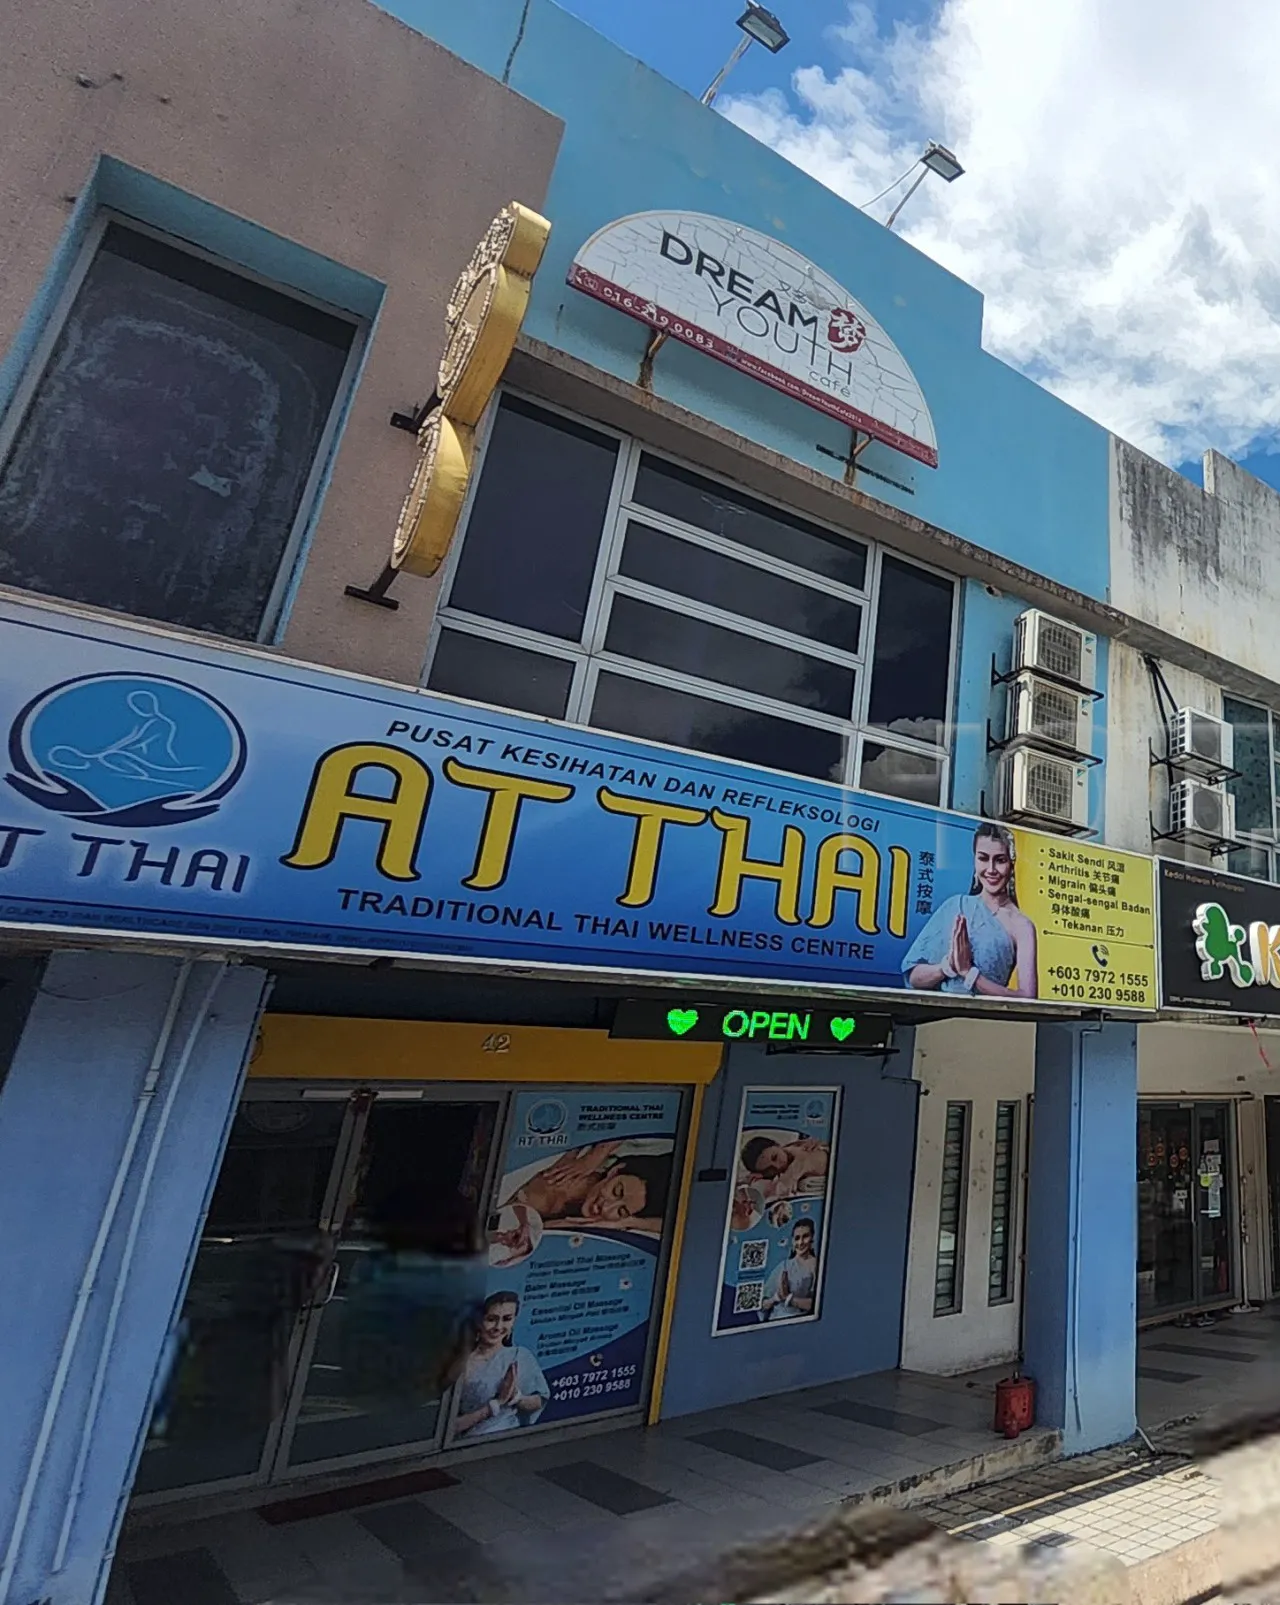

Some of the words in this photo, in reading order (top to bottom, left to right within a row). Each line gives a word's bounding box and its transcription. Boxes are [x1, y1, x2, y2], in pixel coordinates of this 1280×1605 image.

[660, 230, 818, 328] DREAM
[674, 322, 714, 350] 0083
[707, 283, 852, 385] YOUTH
[386, 720, 495, 755] PUSAT
[500, 744, 658, 788] KESIHATAN
[664, 777, 716, 799] DAN
[722, 789, 881, 833] REFLEKSOLOGI
[279, 741, 574, 892] AT
[596, 785, 911, 939] THAI
[0, 824, 46, 869] T
[71, 832, 251, 893] THAI
[1048, 848, 1075, 860] Sakit
[1077, 854, 1105, 868] Sendi
[1048, 862, 1090, 878] Arthritis
[915, 851, 935, 915] 泰式按摩
[1048, 875, 1086, 890] Migrain
[1048, 888, 1119, 910] Sengal-sengal
[1121, 902, 1151, 915] Badan
[338, 888, 563, 931] TRADITIONAL
[574, 914, 638, 939] THAI
[649, 922, 783, 950] WELLNESS
[791, 937, 875, 960] CENTRE
[1061, 918, 1104, 934] Tekanan
[1106, 925, 1125, 937] 压力
[1047, 966, 1080, 981] +603
[1084, 969, 1116, 984] 7972
[1119, 973, 1149, 987] 1555
[1051, 984, 1085, 998] +010
[1088, 986, 1112, 1000] 230
[1115, 988, 1145, 1003] 9588
[722, 1010, 811, 1040] OPEN
[482, 1033, 511, 1053] 42
[518, 1136, 533, 1145] AT
[540, 1135, 568, 1144] THAI
[549, 1280, 587, 1289] Massage
[587, 1298, 623, 1308] Massage
[552, 1375, 579, 1388] +603
[582, 1370, 608, 1382] 7972
[611, 1364, 636, 1378] 1555
[553, 1388, 581, 1401] +010
[582, 1384, 603, 1397] 230
[605, 1379, 631, 1393] 9588
